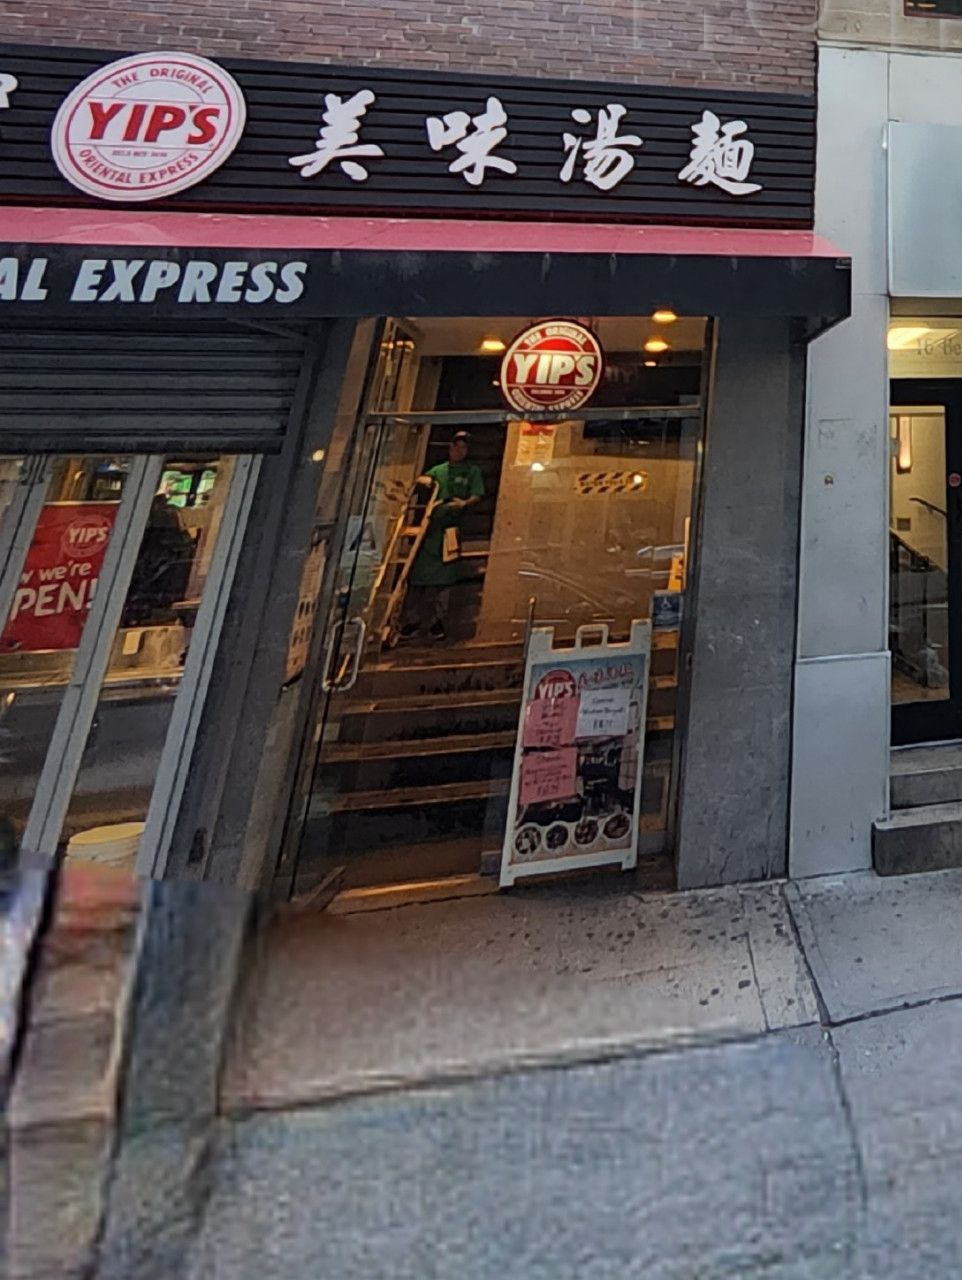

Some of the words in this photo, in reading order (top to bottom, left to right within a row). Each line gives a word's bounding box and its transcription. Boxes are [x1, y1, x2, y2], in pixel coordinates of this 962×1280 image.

[111, 72, 140, 89] THE
[149, 68, 214, 95] ORIGINAL
[88, 101, 221, 145] YIP'S
[79, 148, 133, 184] ORIENTAL
[139, 152, 199, 184] EXPRESS
[70, 259, 308, 303] EXPRESS
[916, 337, 934, 356] 16
[513, 351, 595, 386] YIP'S
[39, 559, 93, 582] we're
